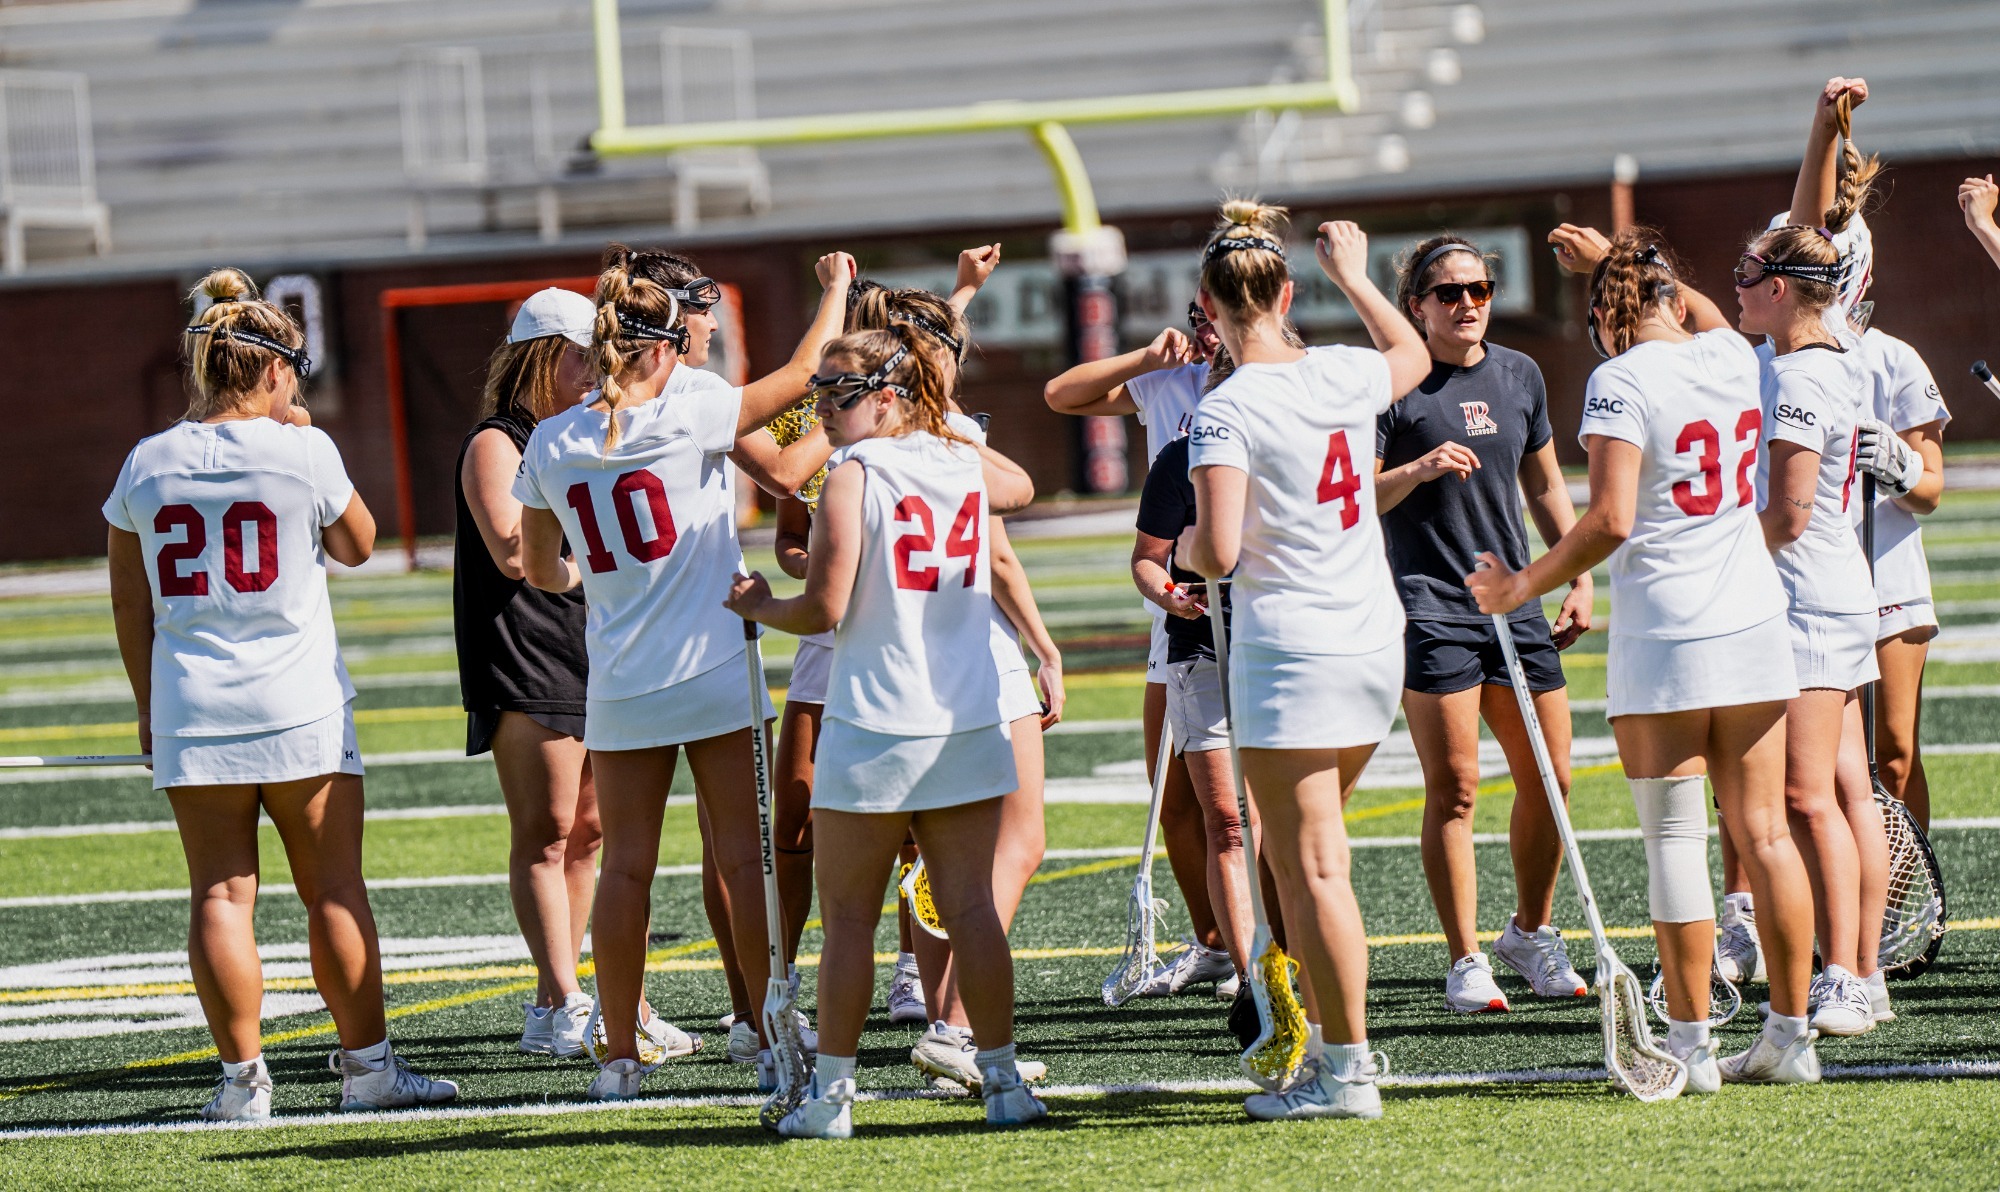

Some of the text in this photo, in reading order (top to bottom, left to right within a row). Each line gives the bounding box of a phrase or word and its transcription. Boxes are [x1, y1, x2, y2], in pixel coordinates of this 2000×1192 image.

[232, 331, 291, 355] UNDER ARMOUR
[647, 327, 679, 339] ARMOUR
[884, 349, 906, 372] STX
[1587, 397, 1624, 414] SAC
[1777, 404, 1817, 426] SAC
[1193, 426, 1230, 440] SAC
[1466, 427, 1498, 437] LACROSSE
[1672, 408, 1763, 517] 32
[1316, 429, 1361, 531] 4
[566, 468, 678, 574] 10
[153, 501, 279, 598] 20
[893, 491, 981, 593] 24
[753, 728, 773, 875] UNDER ARMOUR
